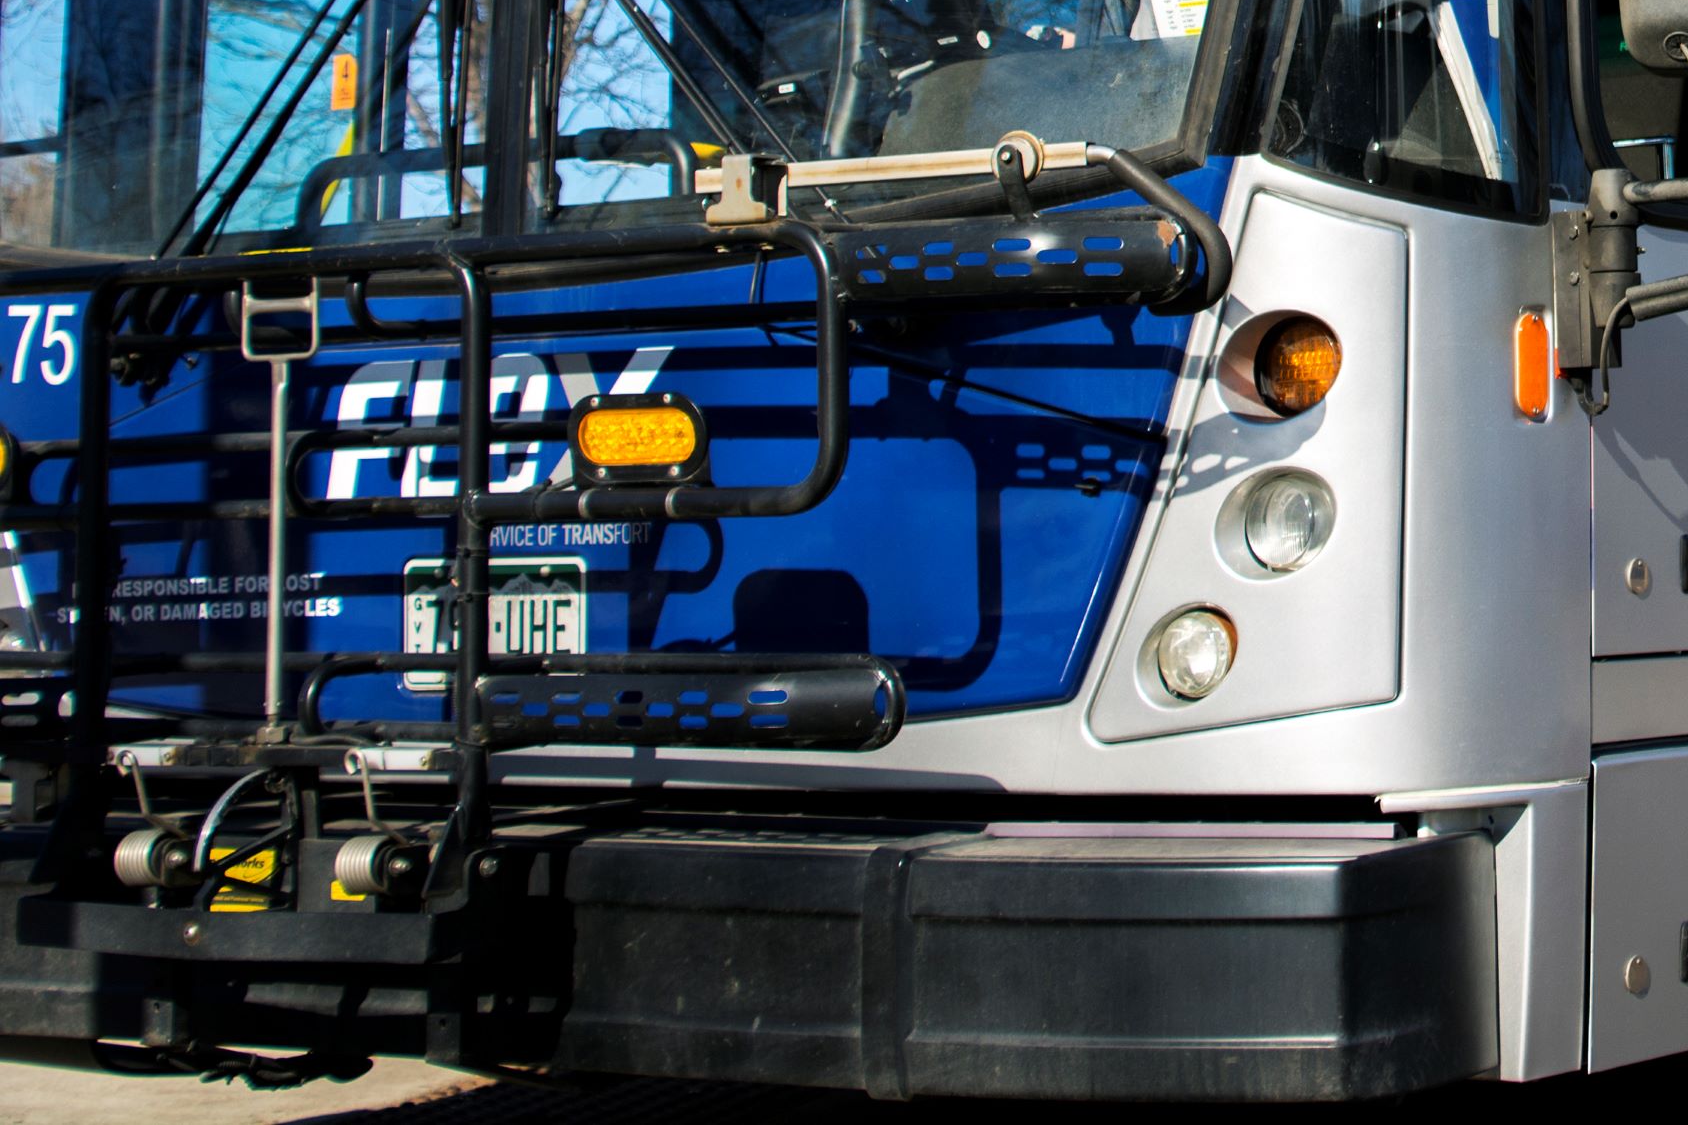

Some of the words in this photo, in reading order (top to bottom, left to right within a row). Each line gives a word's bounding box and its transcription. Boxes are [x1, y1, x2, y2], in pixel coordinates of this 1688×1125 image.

[8, 304, 79, 385] 75
[537, 525, 557, 546] OF
[562, 522, 652, 545] TRANSFORT
[234, 575, 269, 594] FOR
[283, 571, 325, 592] OST
[131, 605, 154, 621] OR
[160, 602, 244, 620] DAMAGED
[250, 596, 342, 618] BIYCLES
